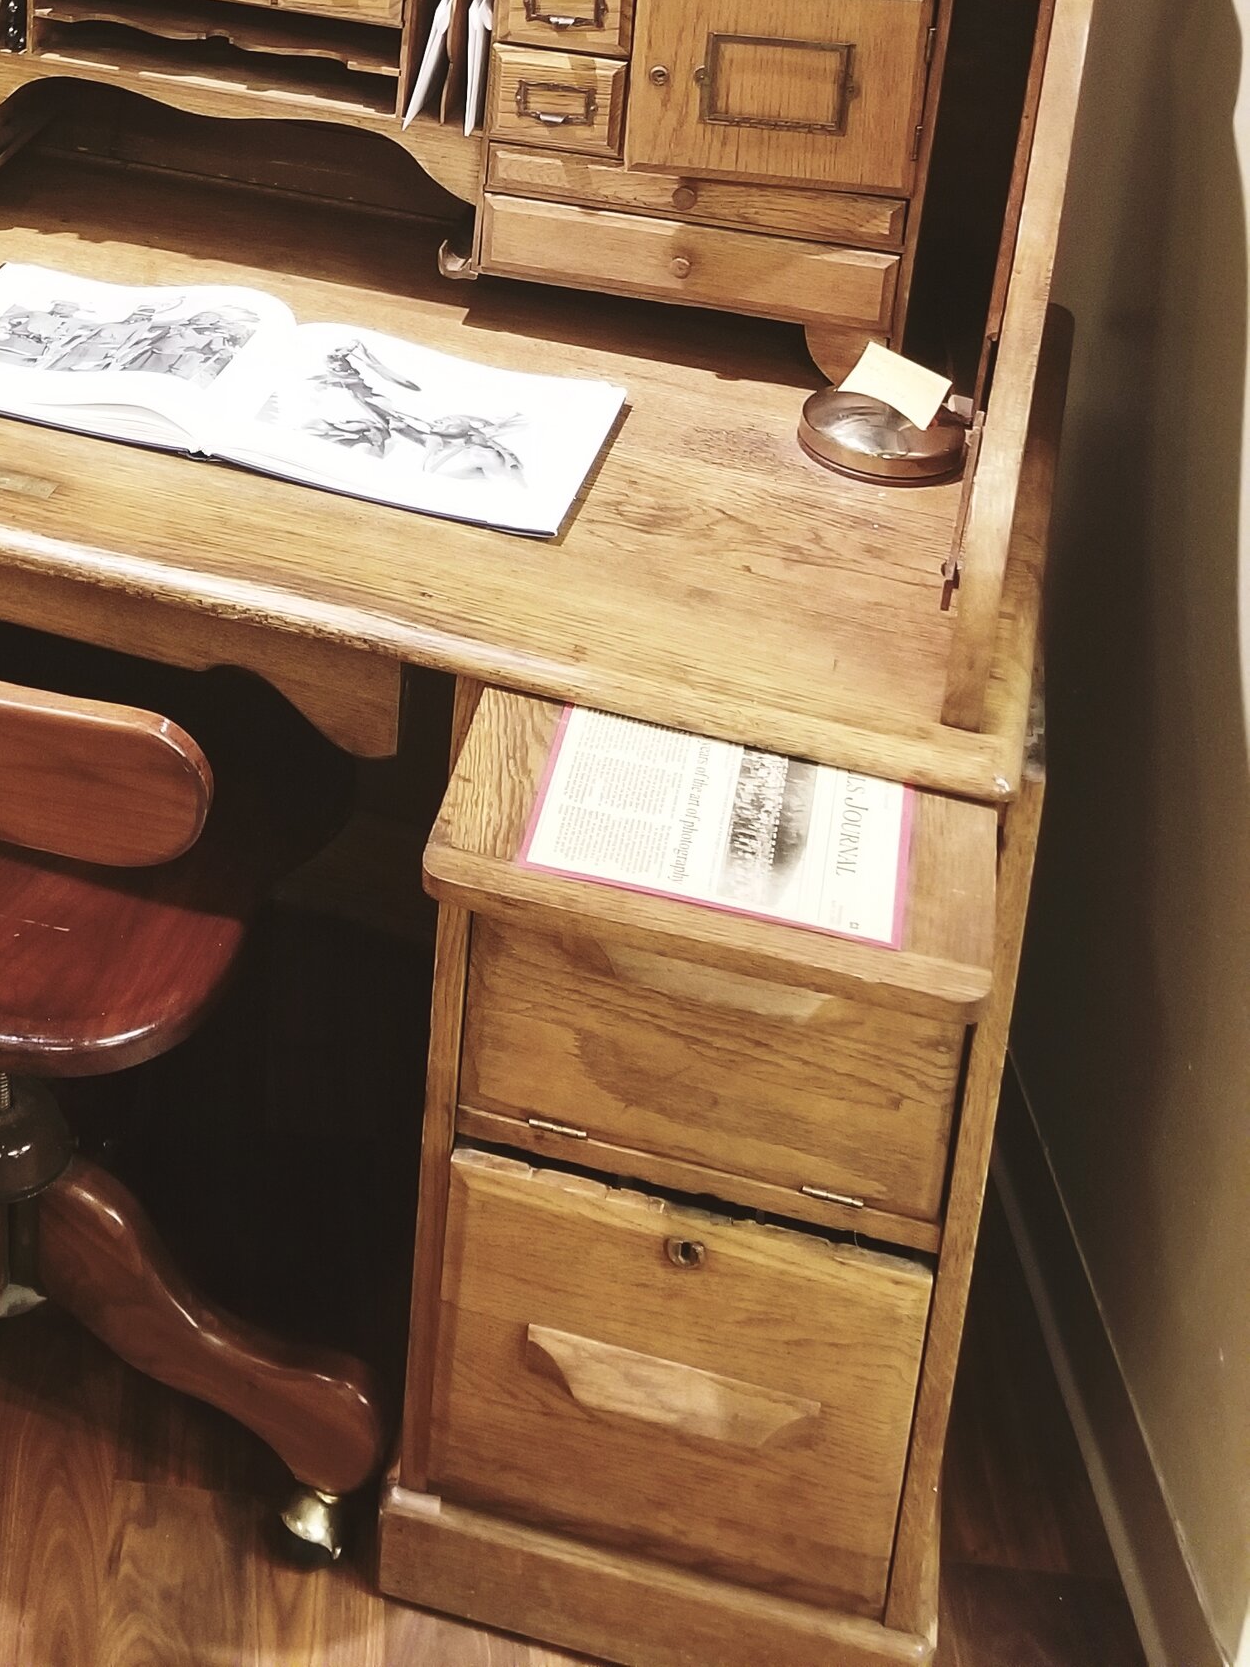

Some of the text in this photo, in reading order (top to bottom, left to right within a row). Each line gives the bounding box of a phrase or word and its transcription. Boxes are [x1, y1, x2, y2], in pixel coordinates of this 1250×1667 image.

[695, 766, 710, 780] of
[691, 777, 708, 792] the
[687, 793, 701, 807] art
[685, 807, 701, 821] of
[835, 796, 869, 876] JOURNAL
[667, 818, 699, 884] photography
